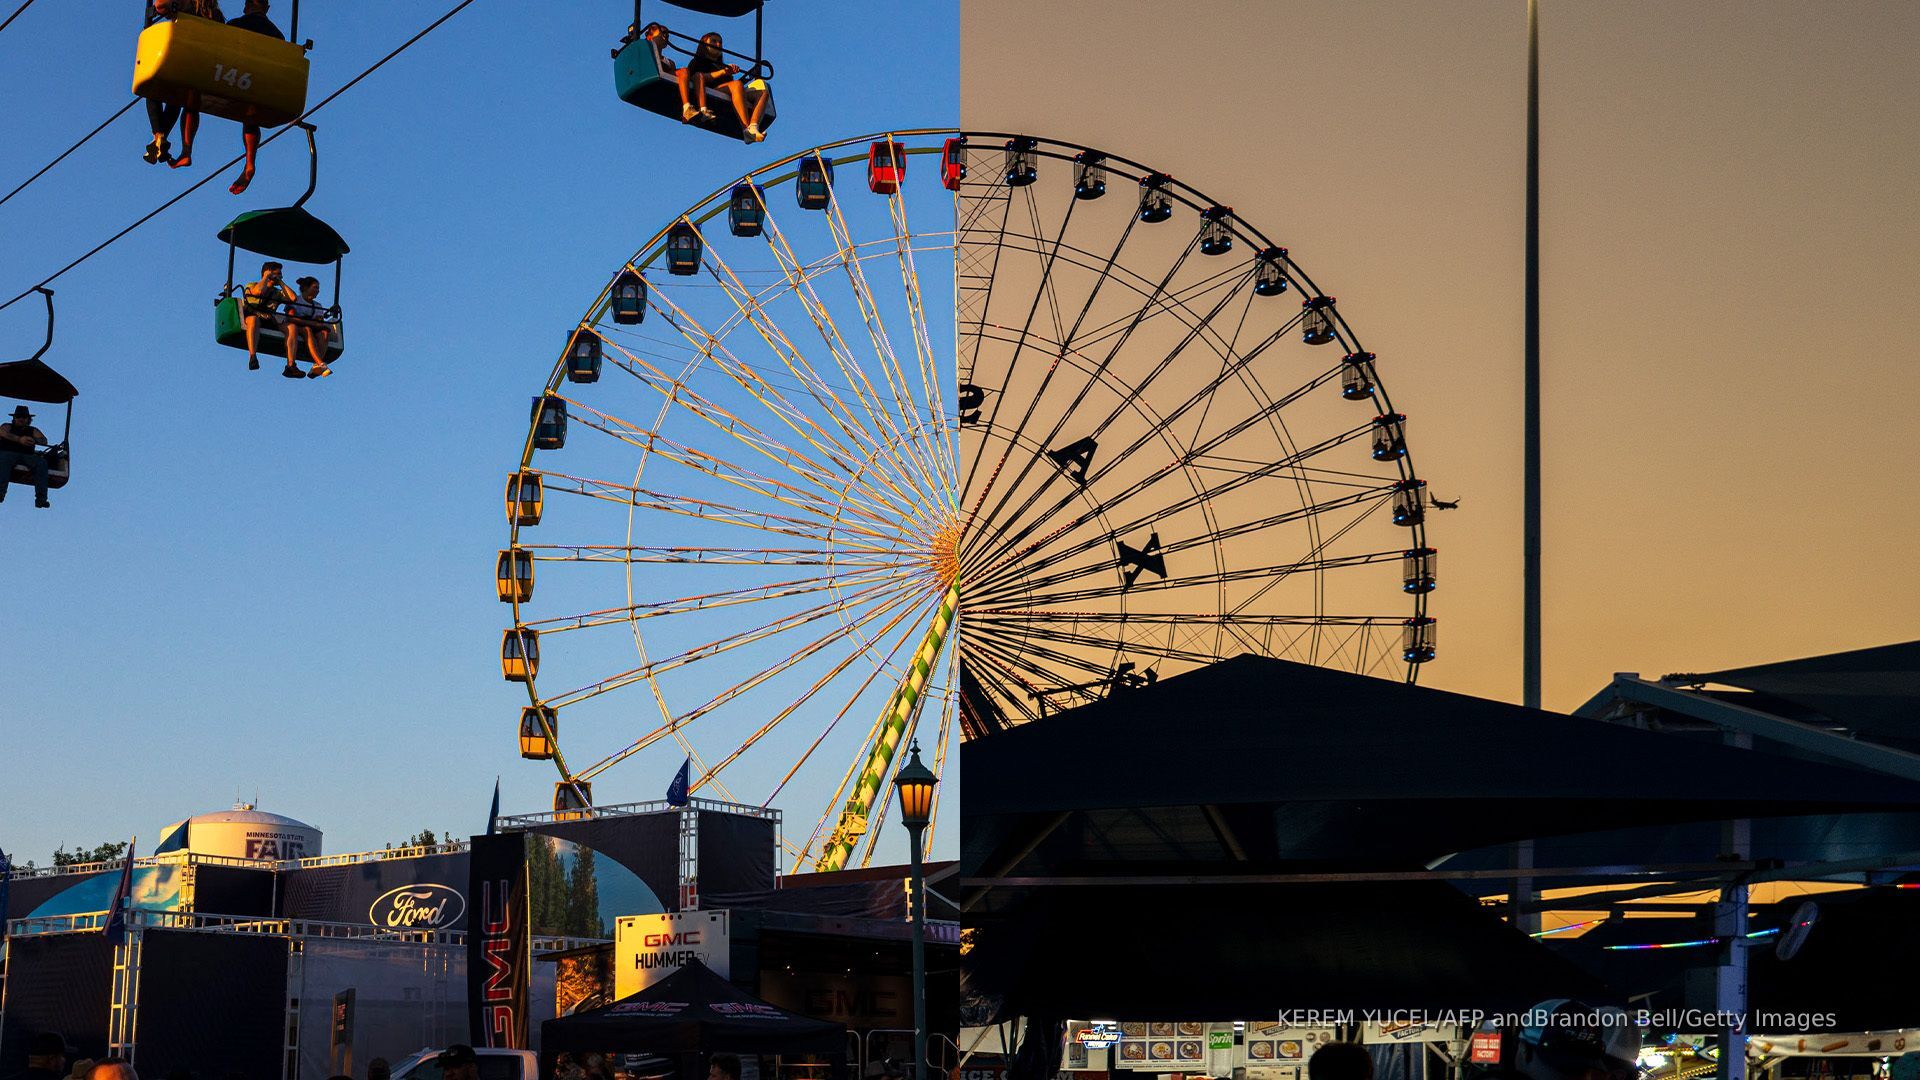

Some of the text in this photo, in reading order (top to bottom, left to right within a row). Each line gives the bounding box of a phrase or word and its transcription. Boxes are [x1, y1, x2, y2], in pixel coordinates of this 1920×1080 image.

[214, 63, 253, 91] 146
[246, 831, 305, 842] MINNESOTA STATE
[246, 839, 306, 860] FAIR
[387, 891, 447, 927] Ford
[644, 931, 701, 948] GMC
[481, 879, 515, 1050] GMC
[635, 950, 696, 970] HUMMER
[611, 1001, 691, 1013] GMC
